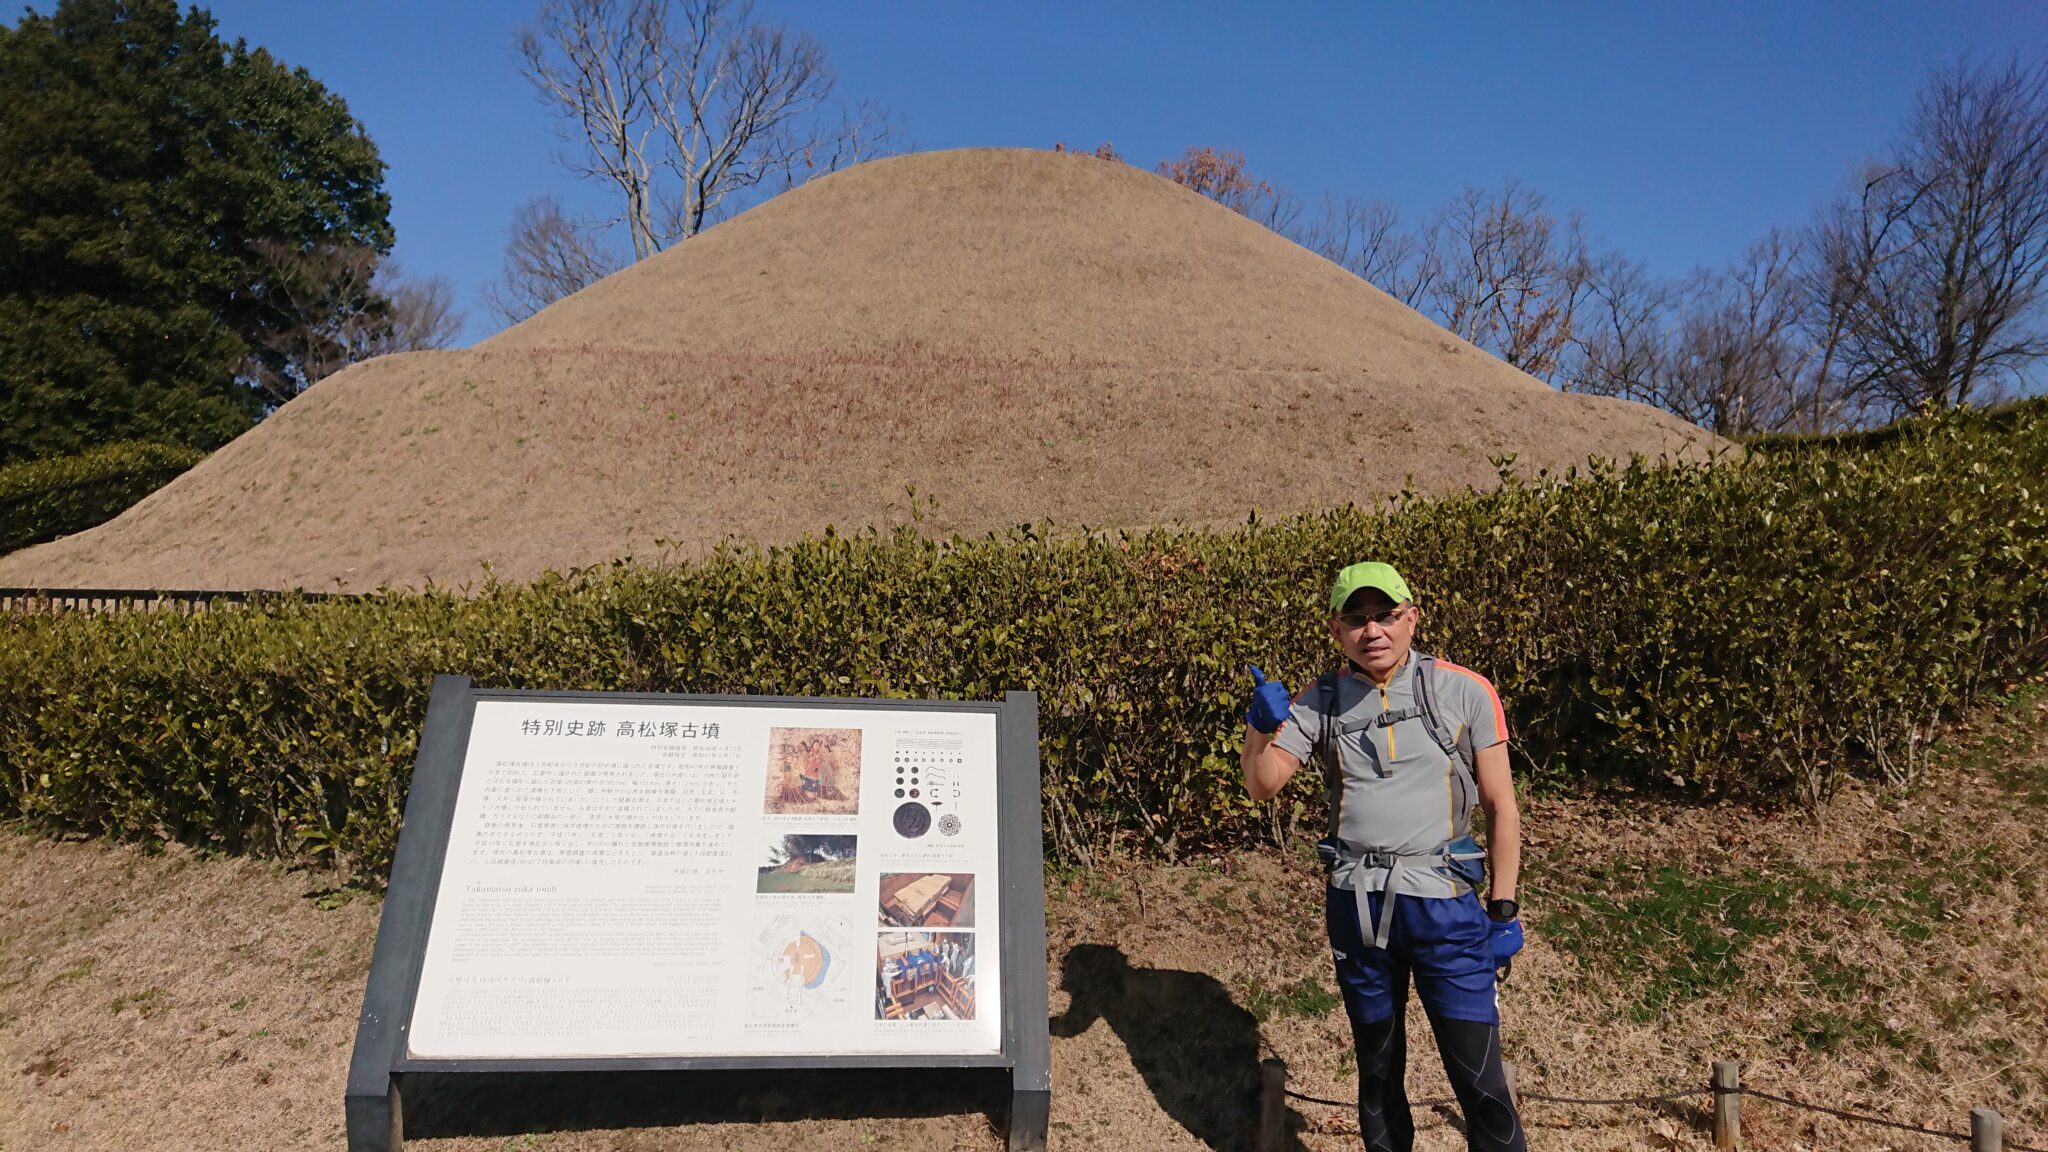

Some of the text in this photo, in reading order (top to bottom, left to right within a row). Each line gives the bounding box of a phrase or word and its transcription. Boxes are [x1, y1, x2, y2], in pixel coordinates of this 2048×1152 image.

[521, 719, 721, 739] 特別史跡 高松塚古墳
